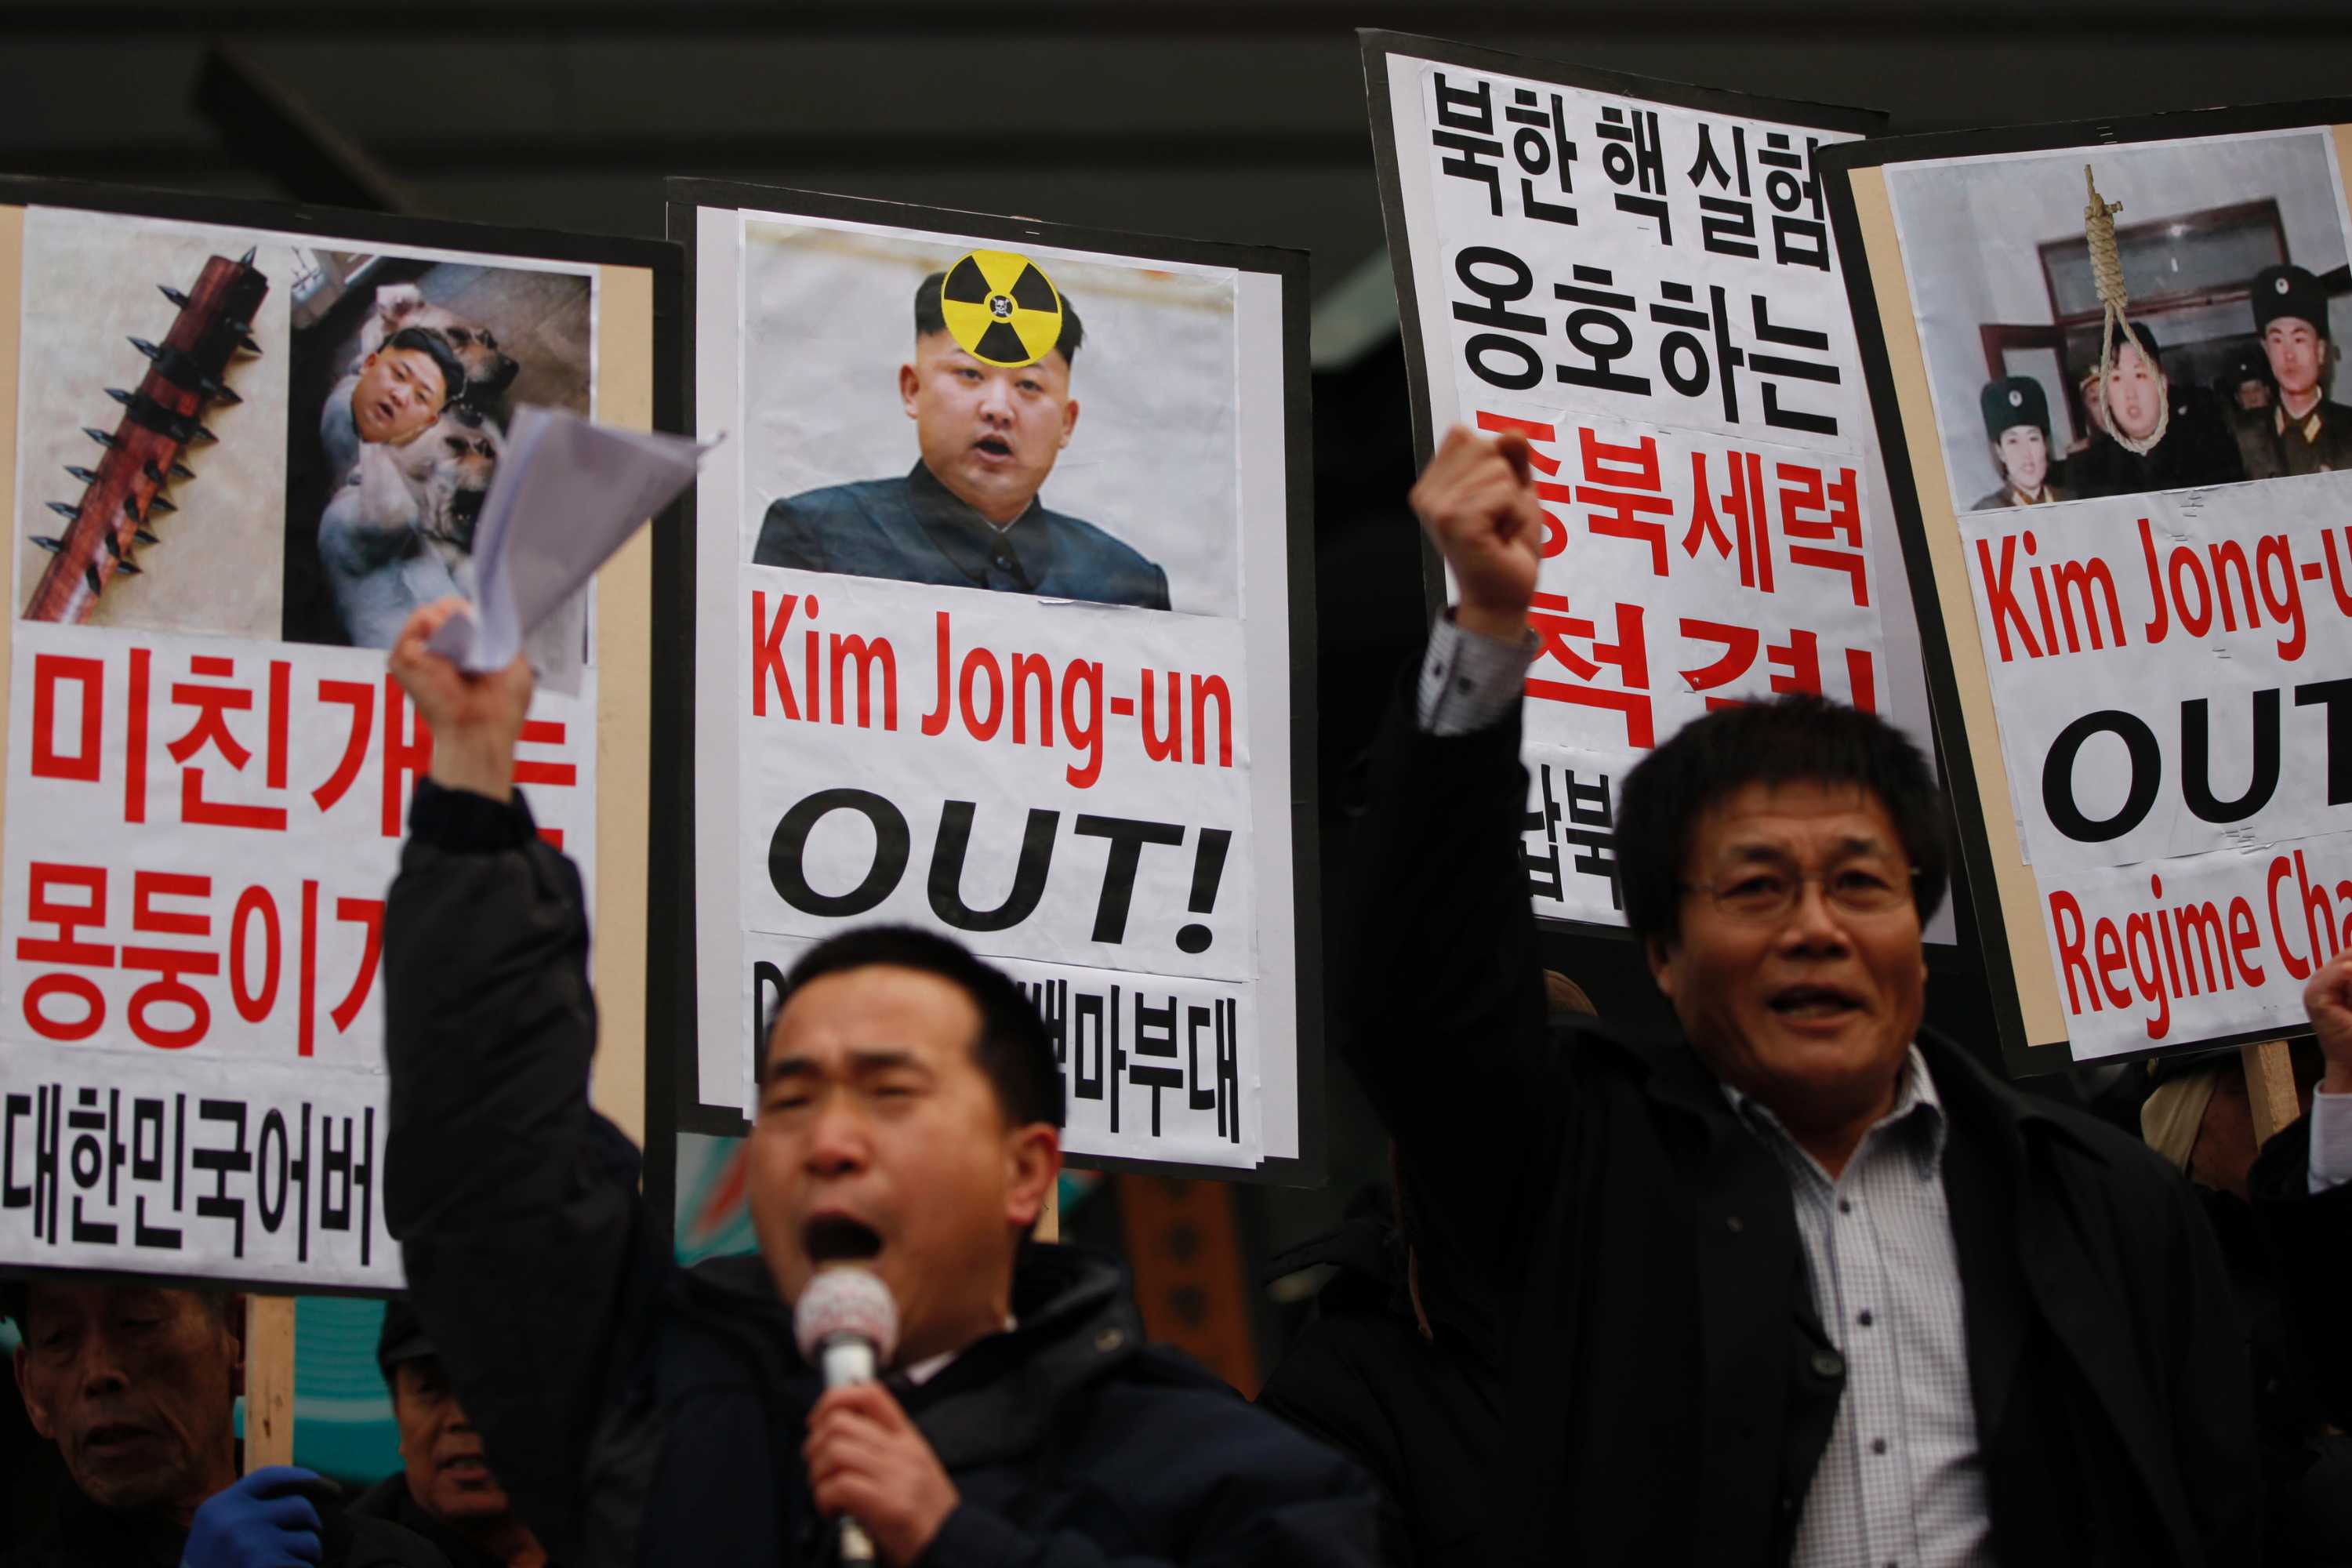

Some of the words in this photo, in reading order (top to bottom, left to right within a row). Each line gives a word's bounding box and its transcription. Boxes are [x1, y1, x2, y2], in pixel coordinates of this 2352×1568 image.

[1432, 71, 1577, 226] 북한
[1595, 106, 1672, 245] 핵
[1687, 123, 1831, 272] 실험
[1452, 246, 1841, 436] 옹호하는
[1976, 530, 2126, 662] Kim
[752, 590, 897, 731] Kim
[921, 612, 1232, 789] Jong-un
[2042, 677, 2352, 843] OUT
[768, 788, 1232, 953] OUT!
[2049, 873, 2266, 1039] Regime
